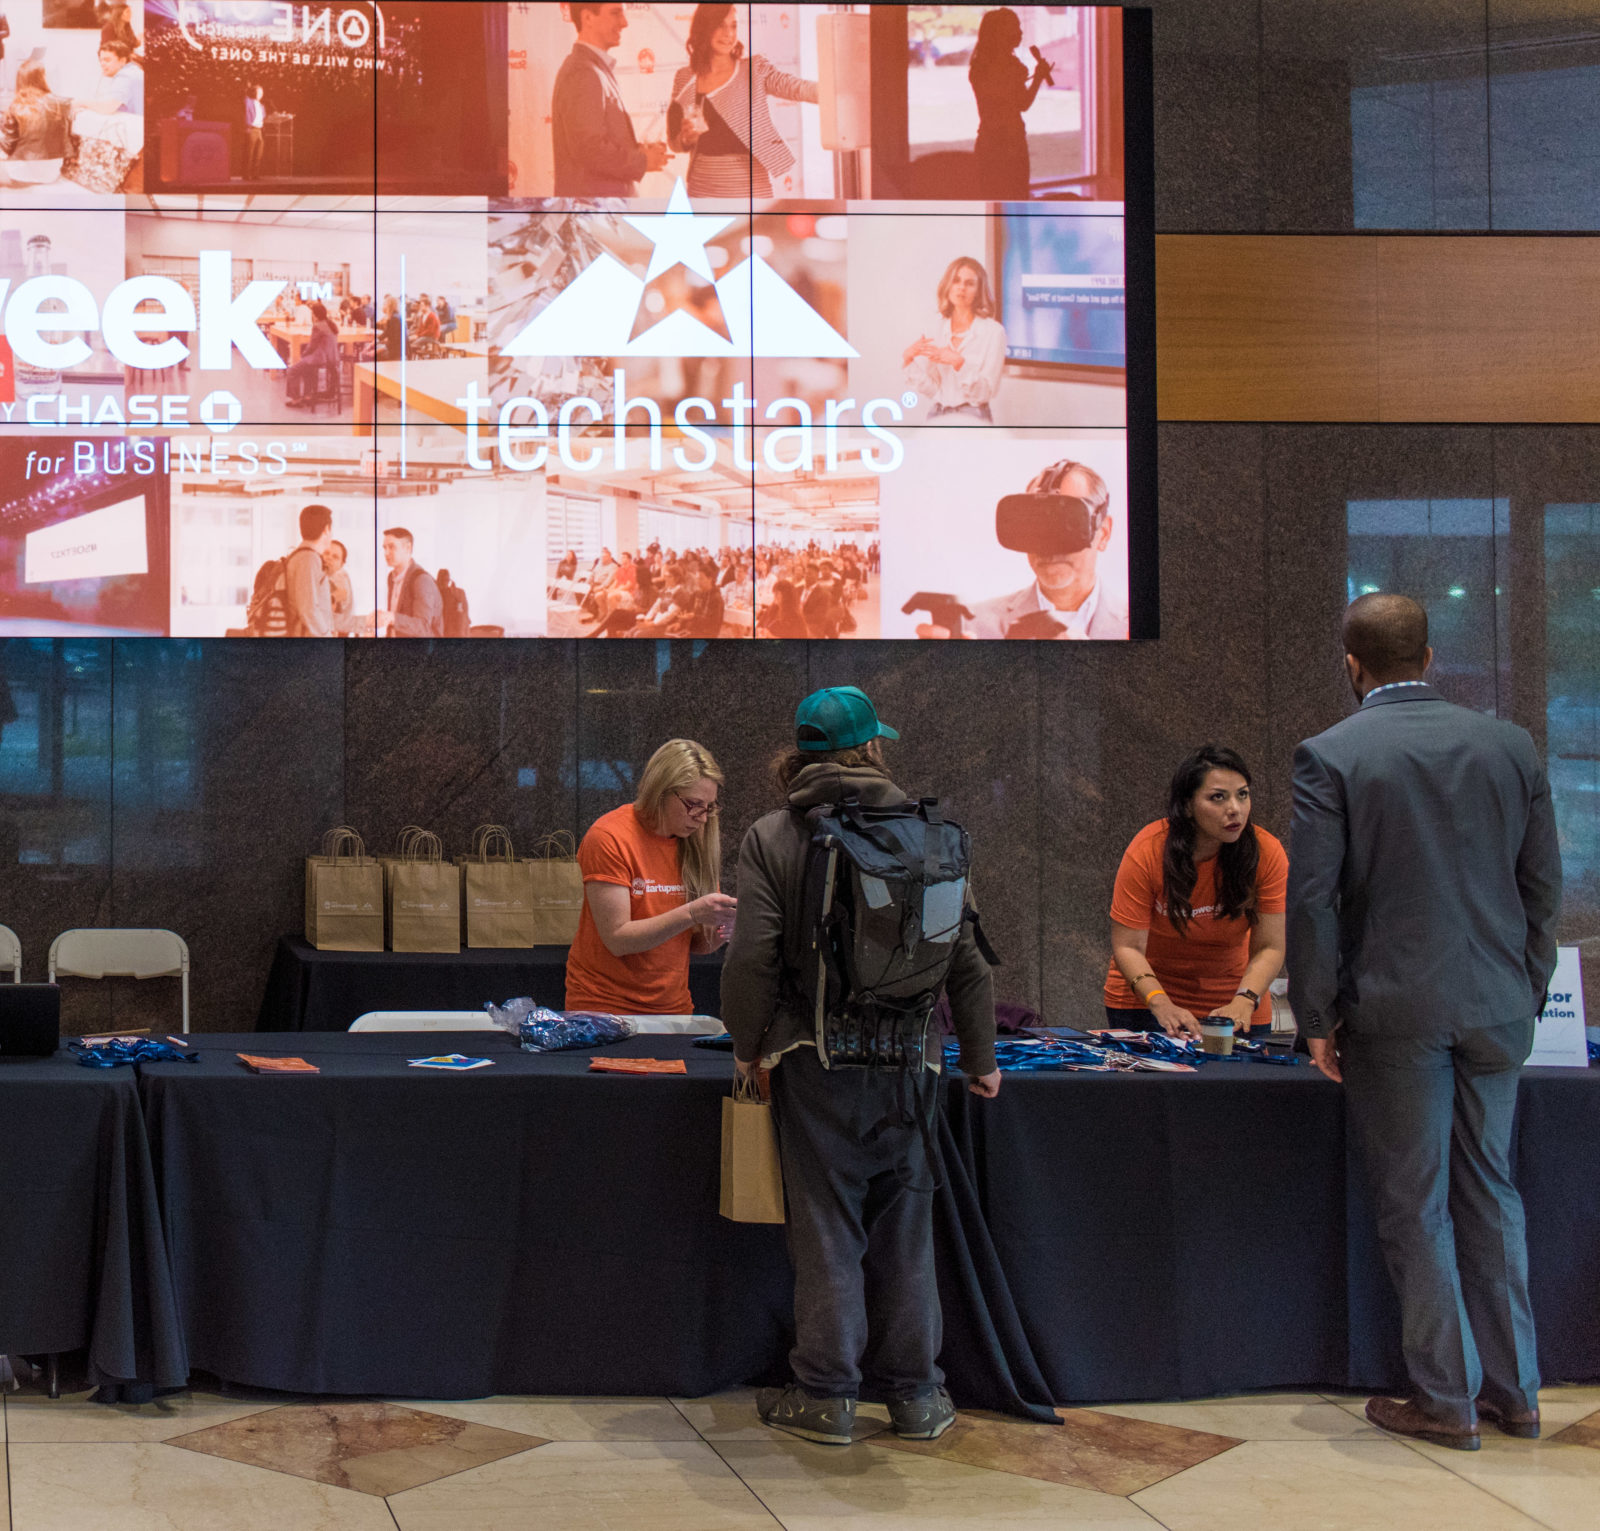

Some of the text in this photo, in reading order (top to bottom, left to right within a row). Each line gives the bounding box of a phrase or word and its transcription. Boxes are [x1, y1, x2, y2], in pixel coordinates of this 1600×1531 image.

[26, 394, 190, 428] CHASE
[455, 369, 906, 473] techstars
[26, 451, 64, 479] for
[74, 441, 287, 476] BUSINESS
